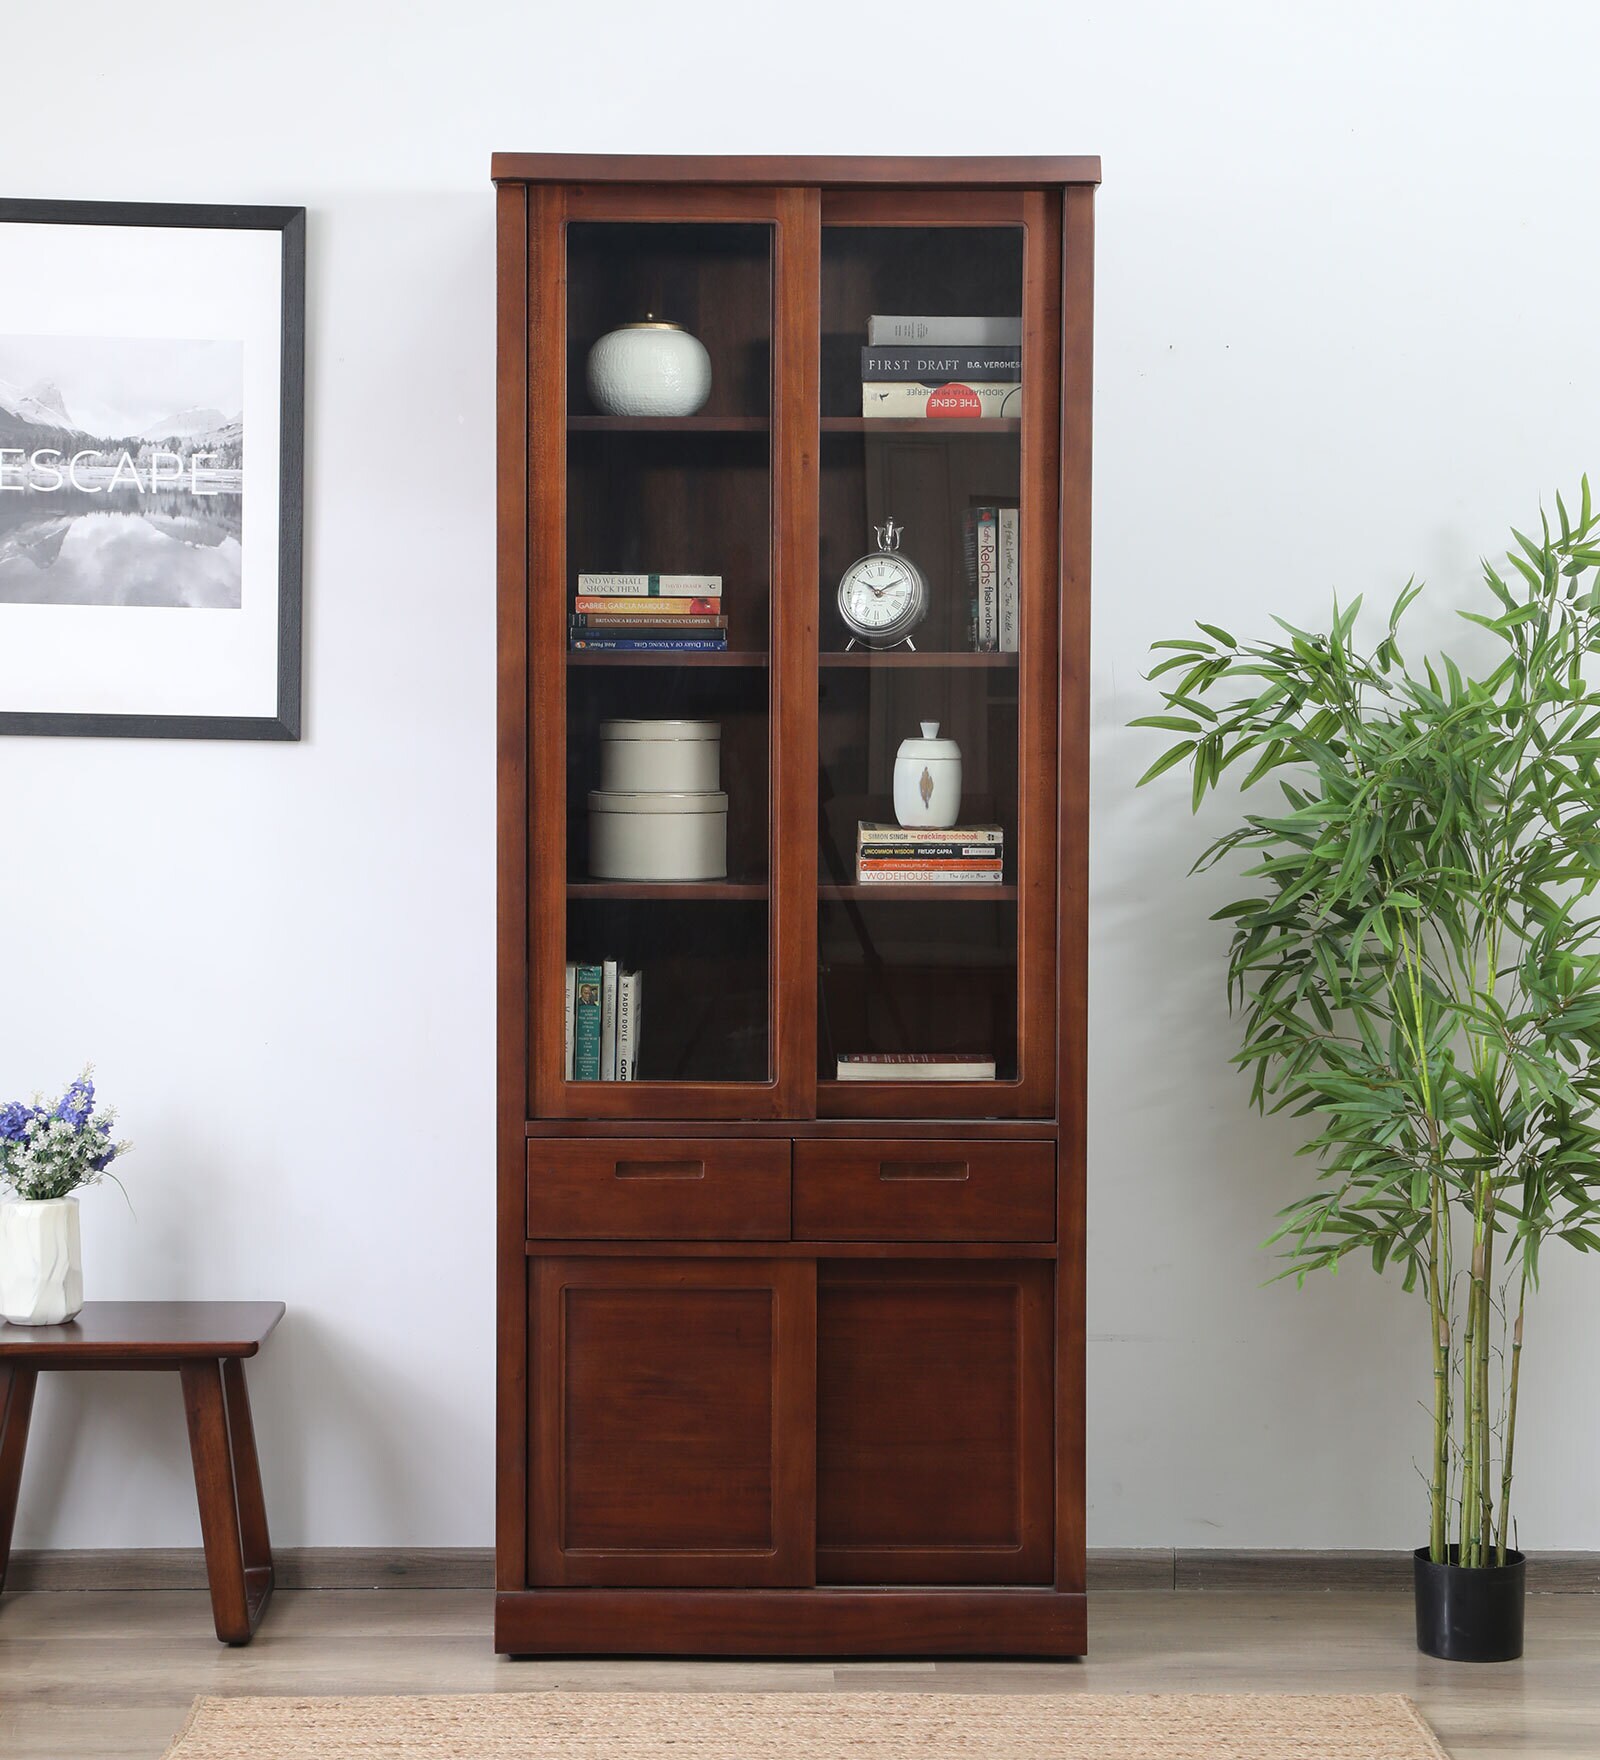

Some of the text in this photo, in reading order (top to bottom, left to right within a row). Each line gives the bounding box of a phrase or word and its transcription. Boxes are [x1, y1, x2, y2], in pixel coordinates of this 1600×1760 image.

[868, 360, 910, 370] FIRST
[917, 360, 960, 370] DRAFT
[967, 361, 982, 369] B.G.
[953, 388, 1004, 396] SIDDHARTHA
[931, 398, 979, 407] THE GENE
[0, 448, 218, 495] ESCAPE
[982, 525, 991, 544] Kathy
[980, 545, 995, 584] Reichs
[618, 577, 643, 585] SHALL
[984, 586, 993, 606] flash
[865, 871, 934, 880] WODEHOUSE
